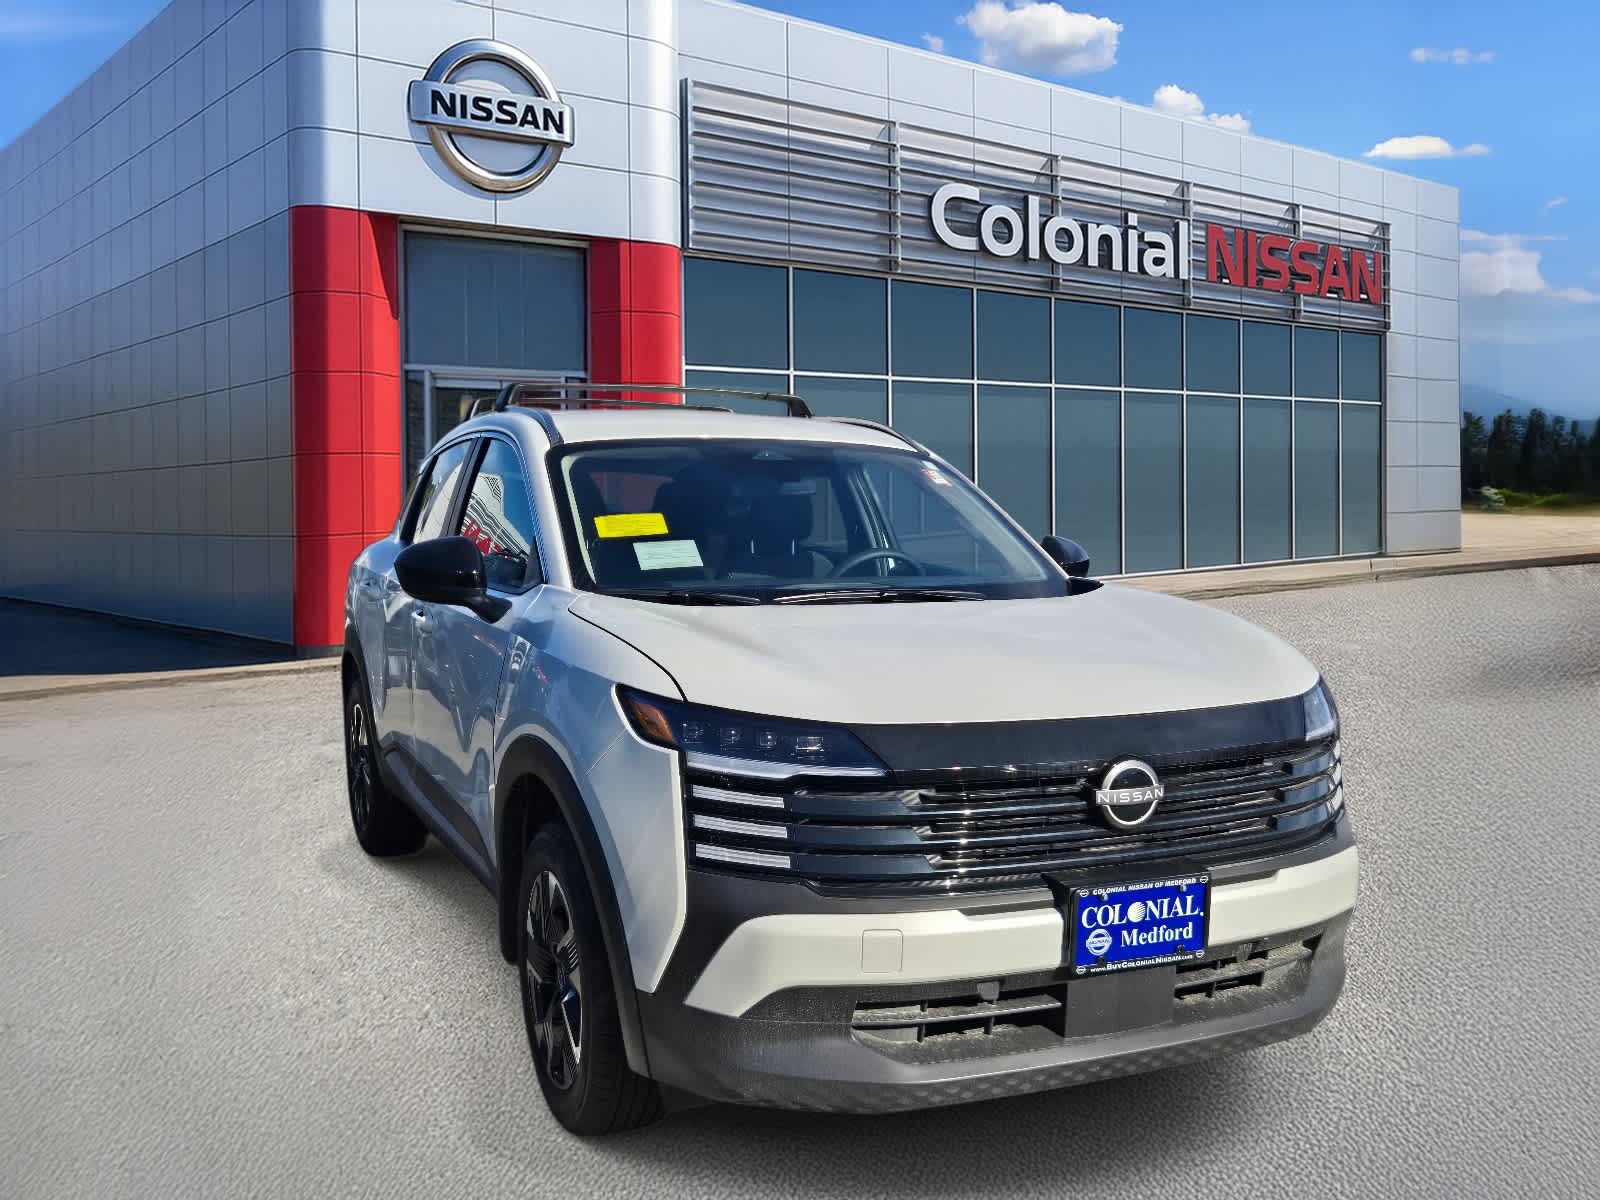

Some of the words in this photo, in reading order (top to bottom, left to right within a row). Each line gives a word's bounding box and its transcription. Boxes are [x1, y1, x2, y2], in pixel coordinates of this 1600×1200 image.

[431, 89, 565, 135] NISSAN
[930, 182, 1189, 280] Colonial
[1206, 223, 1382, 305] NISSAN
[1097, 786, 1164, 803] NISSAN
[1092, 887, 1126, 896] COLONIAL
[1127, 882, 1153, 891] NISSAN
[1154, 880, 1164, 889] OF
[1165, 877, 1197, 887] MEDFORD
[1120, 921, 1193, 948] Medford
